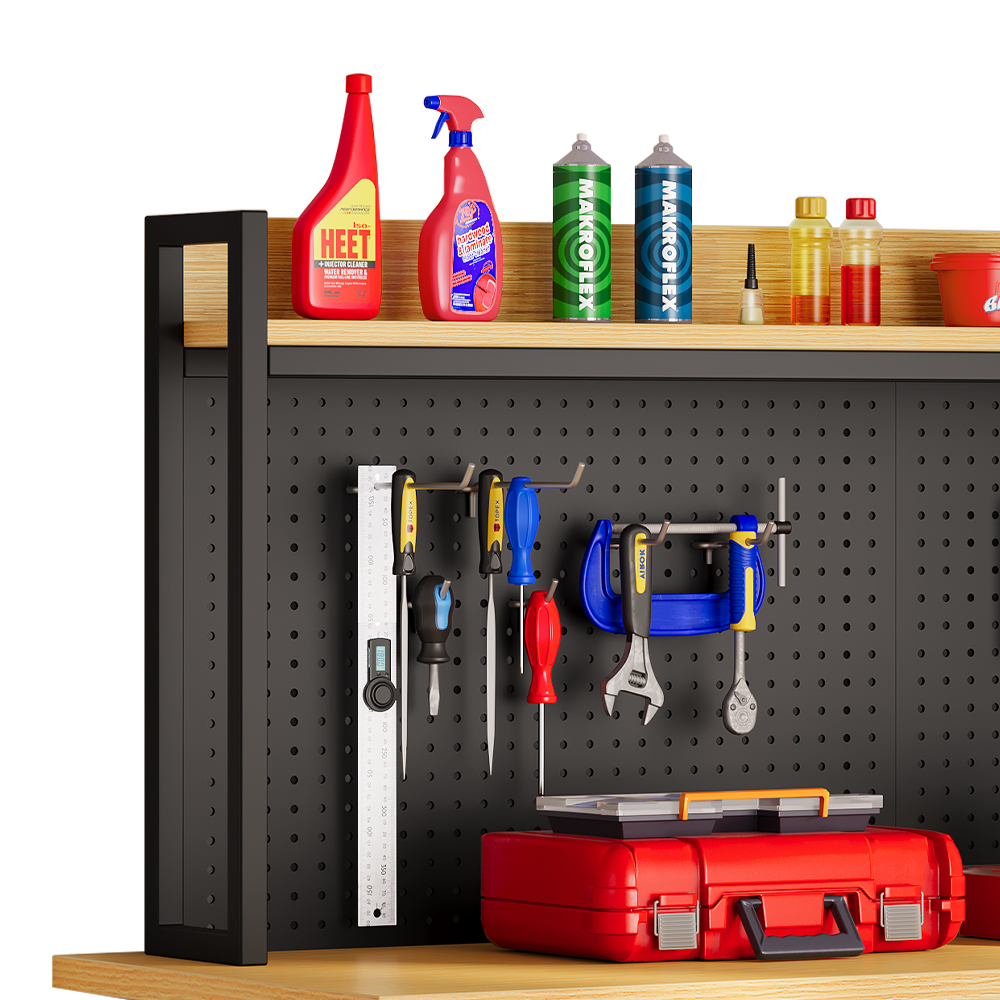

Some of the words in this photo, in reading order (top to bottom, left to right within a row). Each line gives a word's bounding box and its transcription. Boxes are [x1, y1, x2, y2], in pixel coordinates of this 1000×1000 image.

[321, 229, 371, 259] HEET
[456, 223, 490, 246] hardwood
[458, 246, 464, 257] &
[464, 234, 493, 254] laminate
[579, 178, 594, 312] MAKROFLEX
[662, 180, 677, 312] MAKROFLEX
[382, 517, 388, 526] 50
[368, 614, 373, 622] 50
[367, 770, 372, 778] 50
